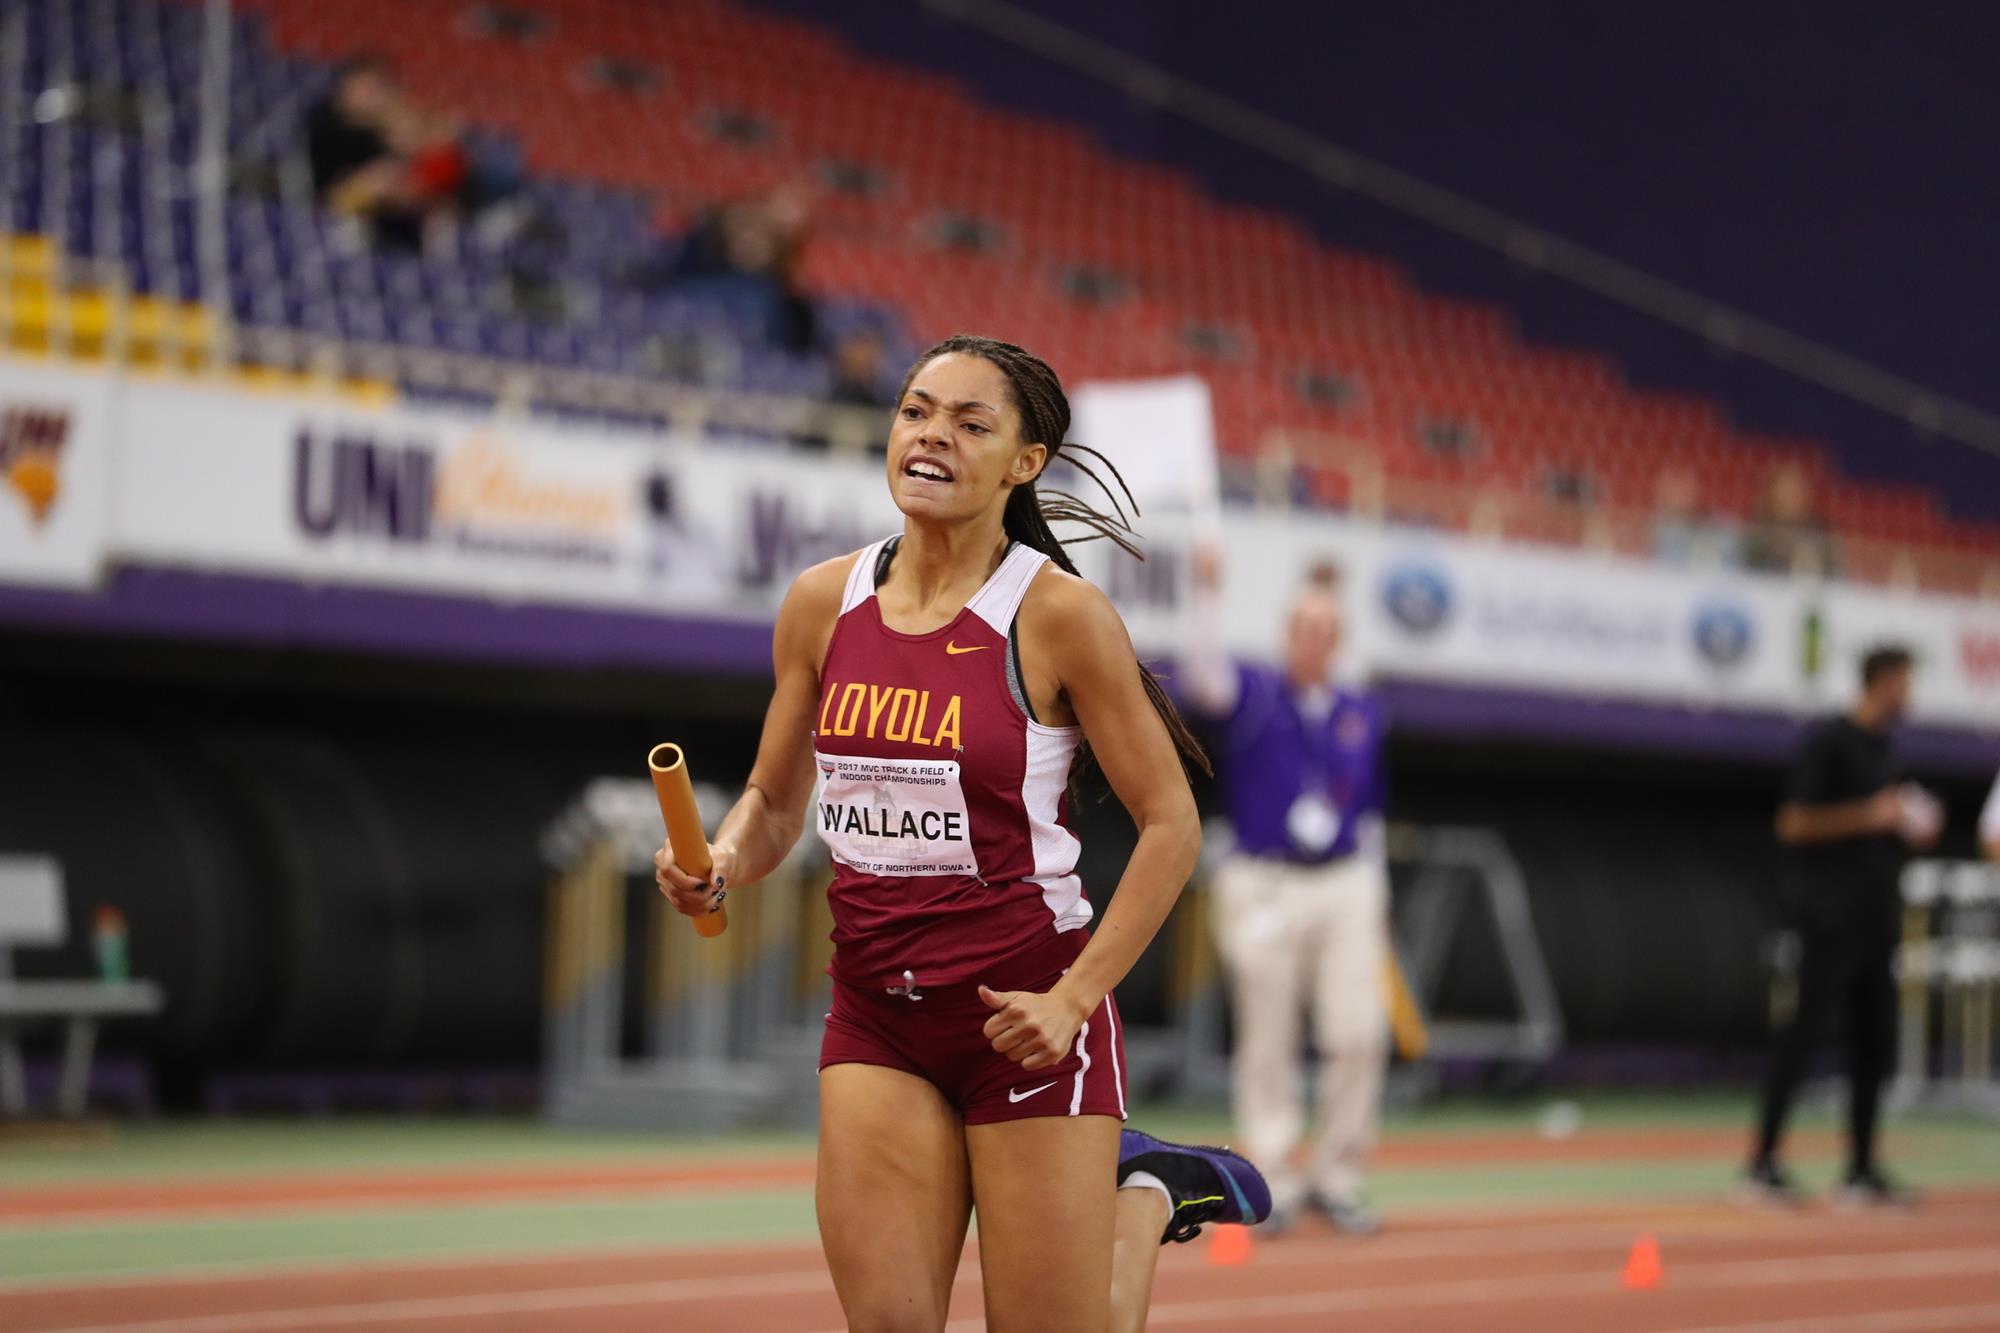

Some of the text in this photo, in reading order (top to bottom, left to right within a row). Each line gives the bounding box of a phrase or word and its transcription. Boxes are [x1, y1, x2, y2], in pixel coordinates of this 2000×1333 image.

[819, 682, 962, 751] LOYOLA
[838, 762, 858, 772] 2017
[860, 764, 880, 773] MVC
[881, 765, 909, 775] TRACK
[911, 767, 917, 775] &
[920, 767, 945, 776] FIELD
[840, 773, 946, 786] INDOOR CHAMPIONSHIPS
[819, 802, 963, 842] WALLACE
[872, 863, 883, 872] OF
[885, 864, 936, 873] NORTHERN
[938, 864, 964, 872] IOWA
